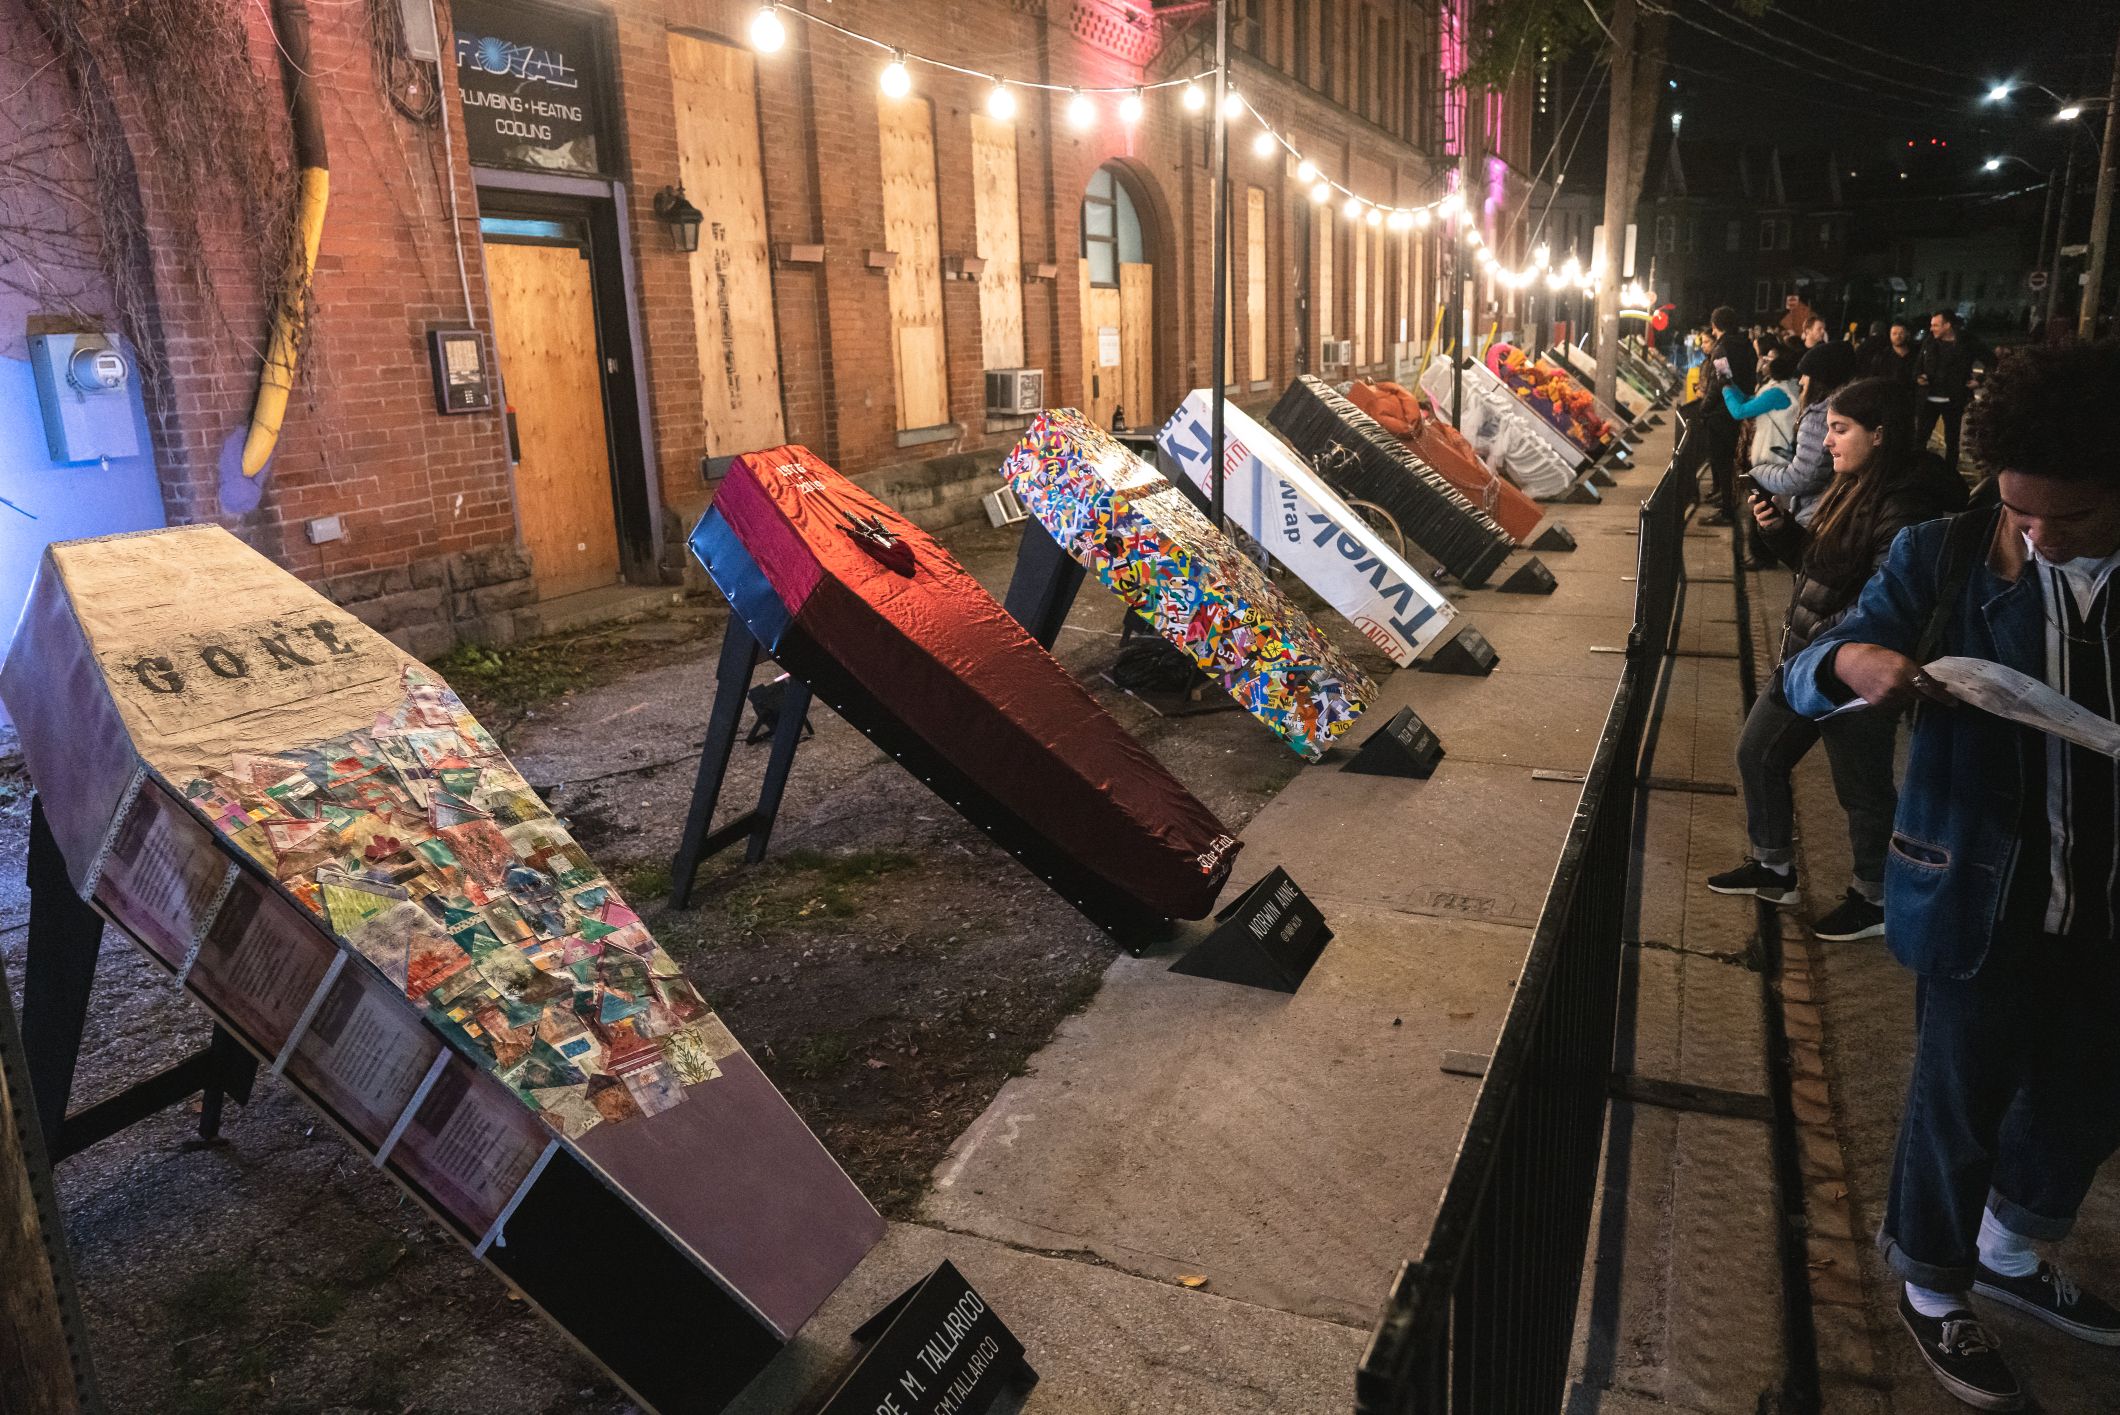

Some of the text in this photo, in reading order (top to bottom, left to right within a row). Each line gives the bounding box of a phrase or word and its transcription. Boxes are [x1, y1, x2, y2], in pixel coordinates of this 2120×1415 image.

[531, 100, 583, 122] HEATING
[495, 119, 552, 141] COOLING
[796, 480, 826, 495] 2019
[130, 619, 354, 695] GONE
[1196, 851, 1219, 868] The
[1210, 834, 1234, 855] End
[1248, 880, 1299, 940] NORWIN ANNE
[899, 1370, 927, 1402] M.
[917, 1289, 985, 1375] TALLARICO
